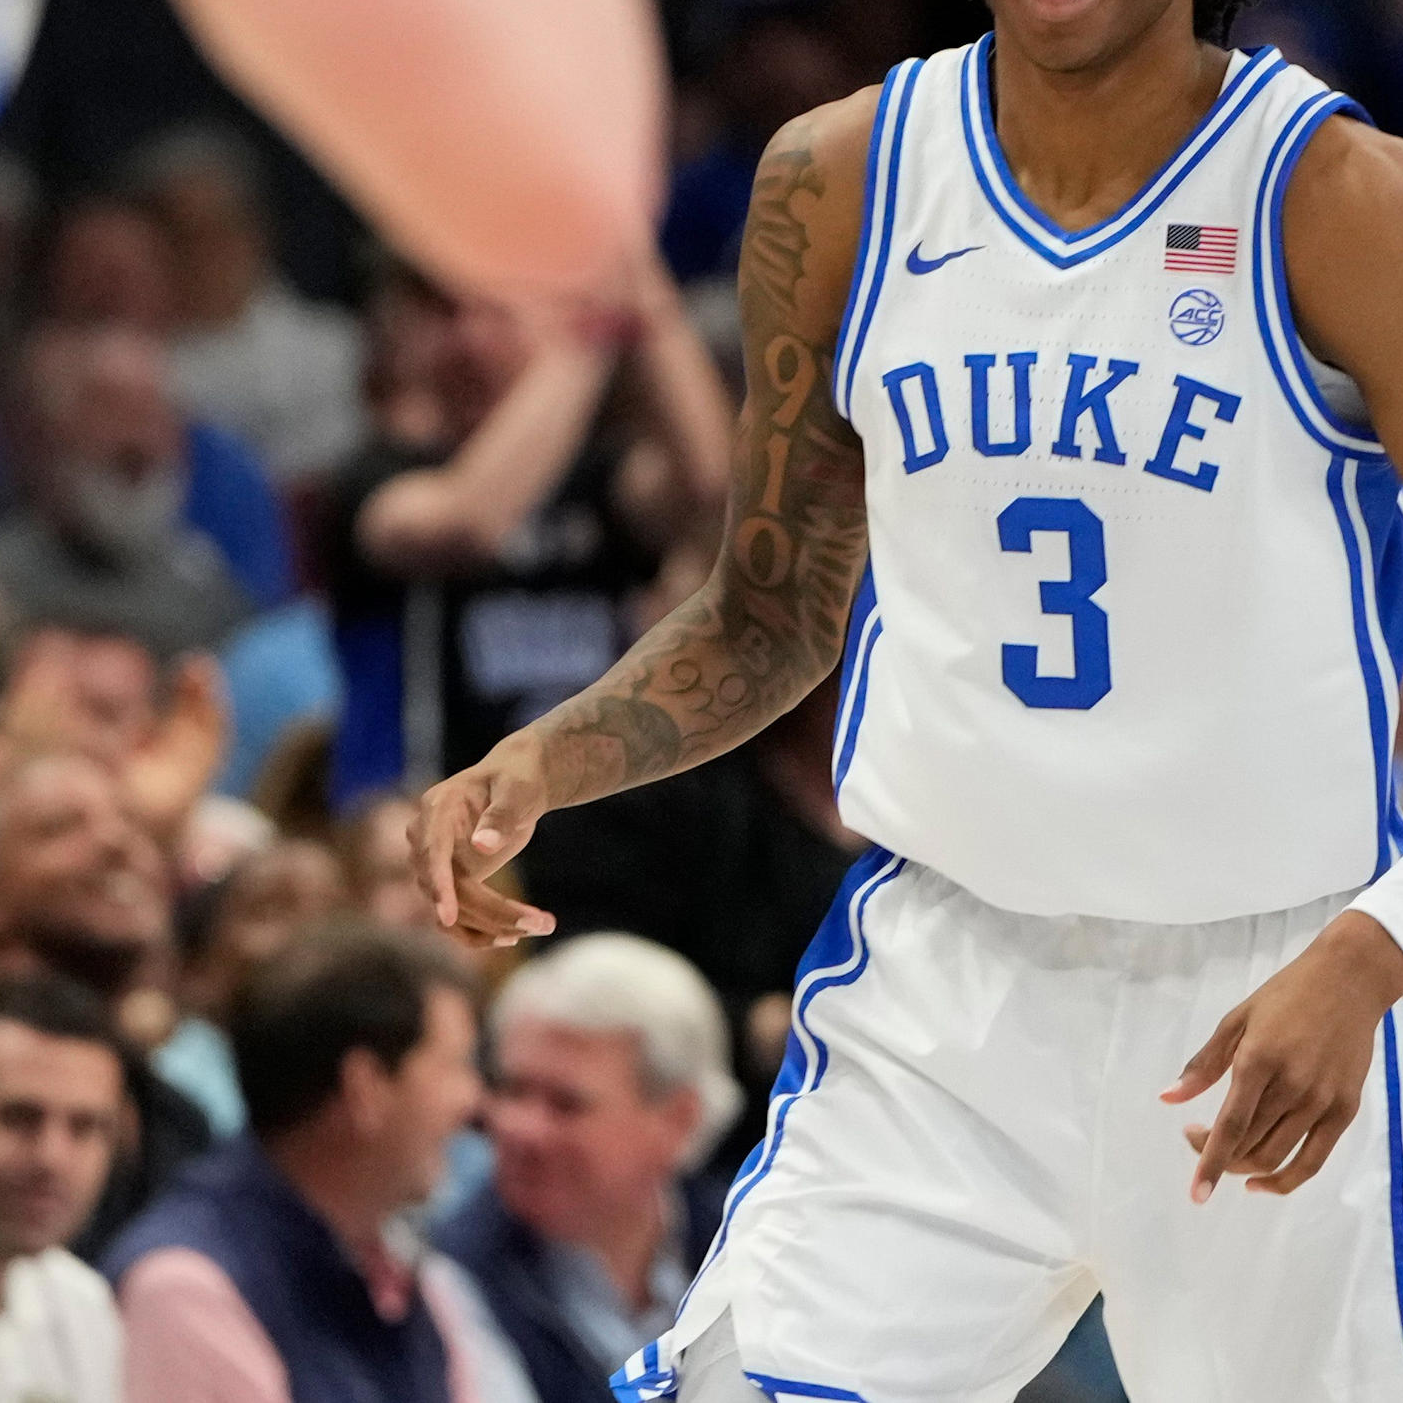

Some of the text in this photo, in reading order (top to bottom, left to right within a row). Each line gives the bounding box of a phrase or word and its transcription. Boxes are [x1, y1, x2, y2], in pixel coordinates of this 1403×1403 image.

[1177, 308, 1222, 327] ACC
[883, 351, 1242, 493] DUKE
[996, 496, 1114, 711] 3
